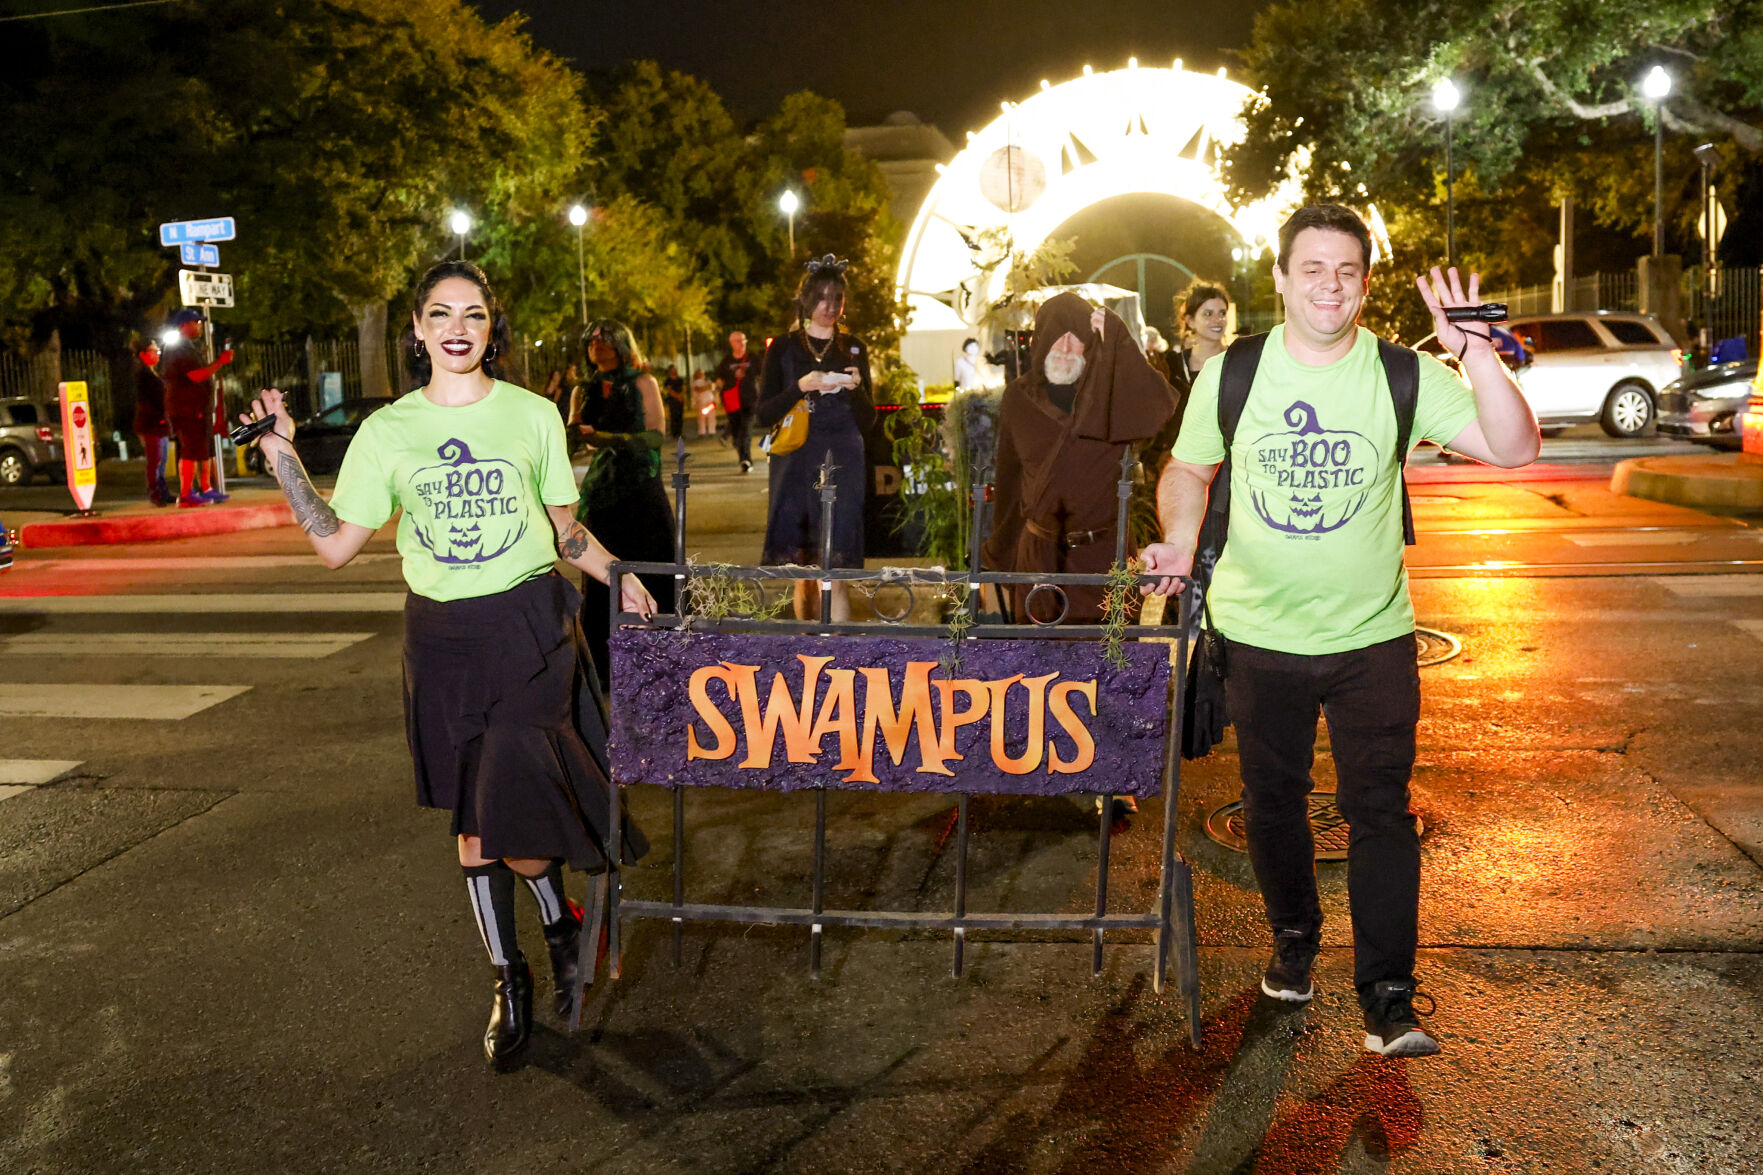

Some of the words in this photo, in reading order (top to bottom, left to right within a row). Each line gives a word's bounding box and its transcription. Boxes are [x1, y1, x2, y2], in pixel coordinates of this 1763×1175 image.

[169, 227, 178, 239] N
[185, 221, 226, 239] Rampart
[185, 246, 195, 260] St
[200, 247, 215, 262] Ann
[211, 285, 226, 297] WAY
[1258, 448, 1288, 462] SAY
[1290, 439, 1351, 468] BOO
[415, 480, 442, 496] SAY
[445, 468, 503, 497] BOO
[1262, 463, 1277, 474] TO
[1277, 467, 1364, 489] PLASTIC
[433, 496, 518, 519] PLASTIC
[687, 654, 1098, 784] SWAMPUS
